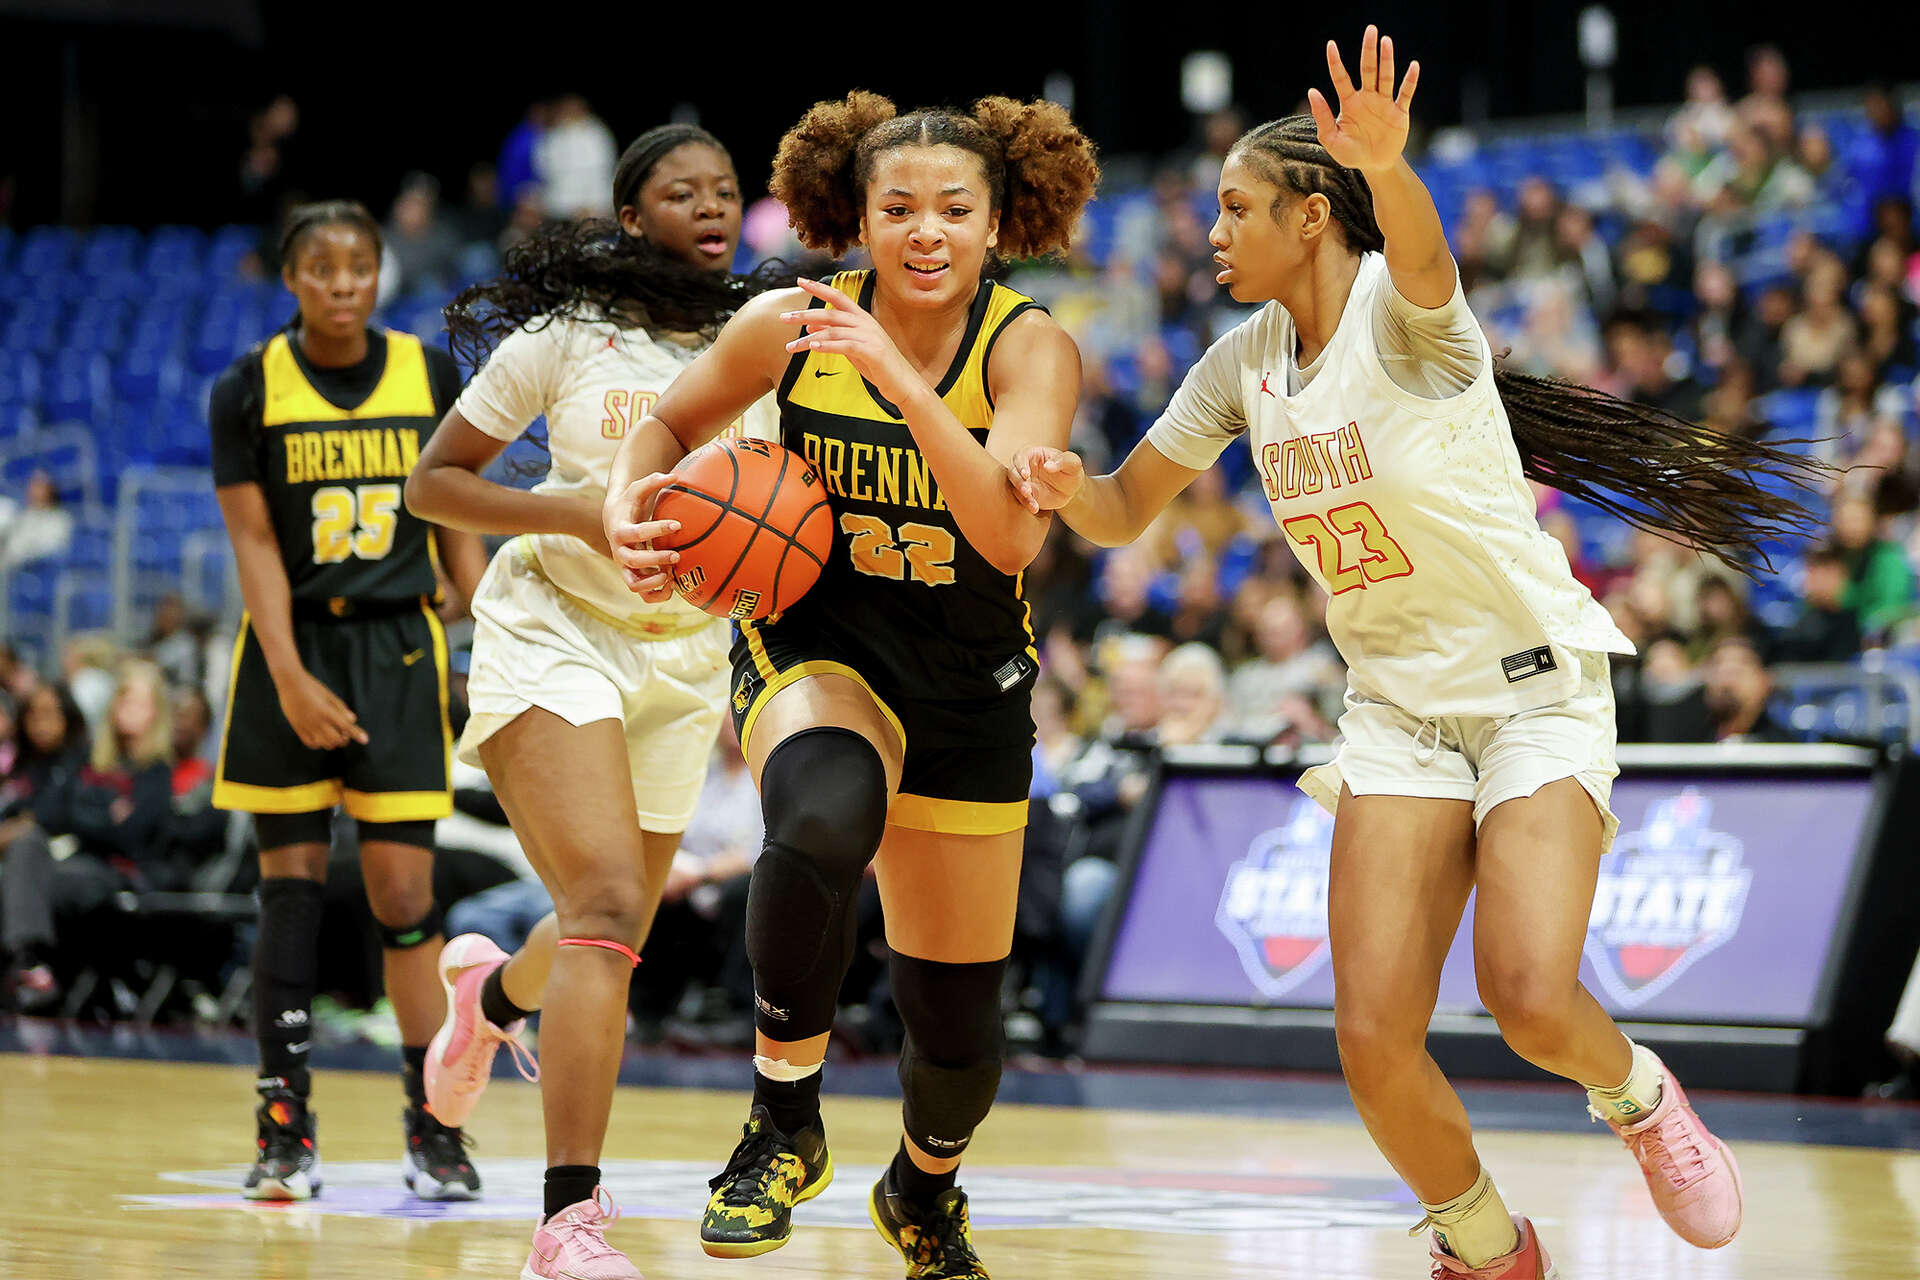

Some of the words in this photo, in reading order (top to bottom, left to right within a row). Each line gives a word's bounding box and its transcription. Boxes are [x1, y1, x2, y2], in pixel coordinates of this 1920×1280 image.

[285, 428, 419, 484] BRENNAN
[803, 432, 950, 511] BRENN
[1262, 421, 1373, 501] SOUTH
[312, 483, 401, 564] 25
[839, 512, 957, 587] 22
[1283, 501, 1415, 595] 23
